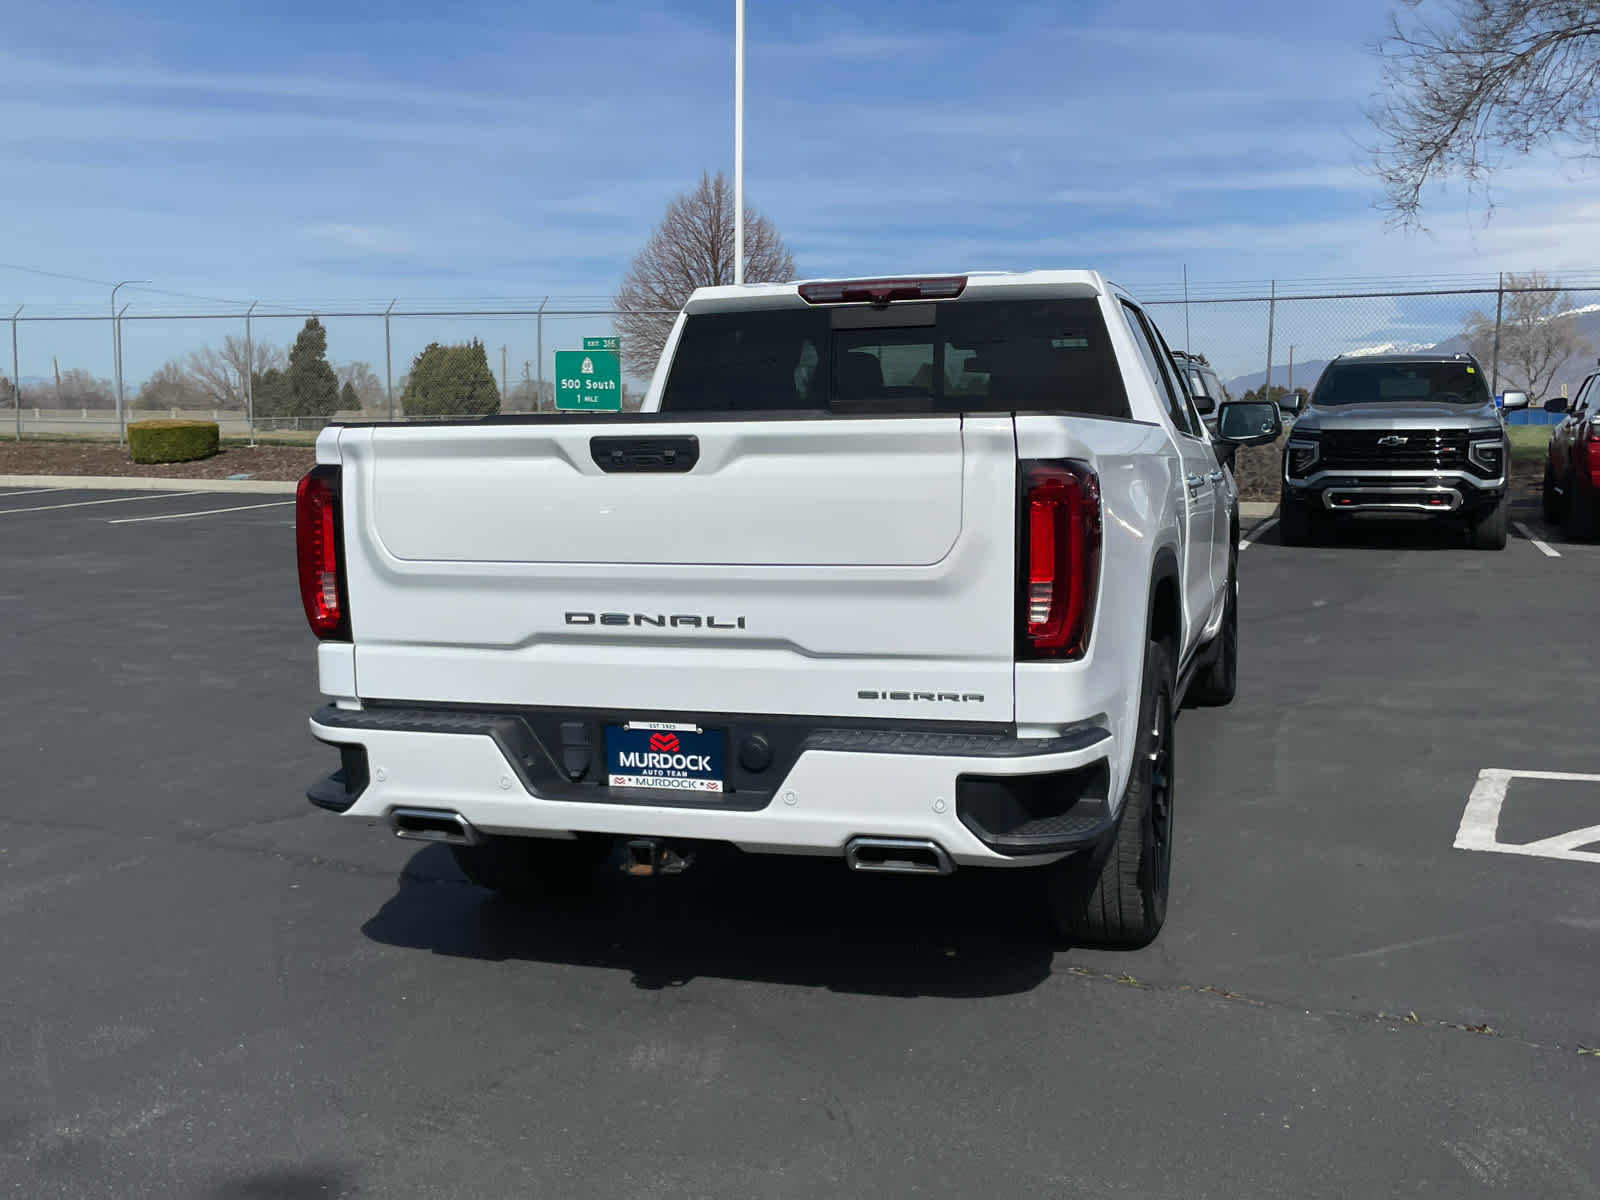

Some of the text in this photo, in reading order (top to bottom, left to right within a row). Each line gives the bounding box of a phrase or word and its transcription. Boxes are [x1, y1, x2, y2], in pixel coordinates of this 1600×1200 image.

[561, 379, 615, 390] 500 South
[577, 394, 581, 403] 1
[565, 612, 746, 629] DENALI
[857, 690, 985, 703] SIERRA
[619, 751, 712, 772] MURDOCK
[642, 768, 688, 777] AUTO TEAM
[635, 777, 697, 789] MURDOCK
